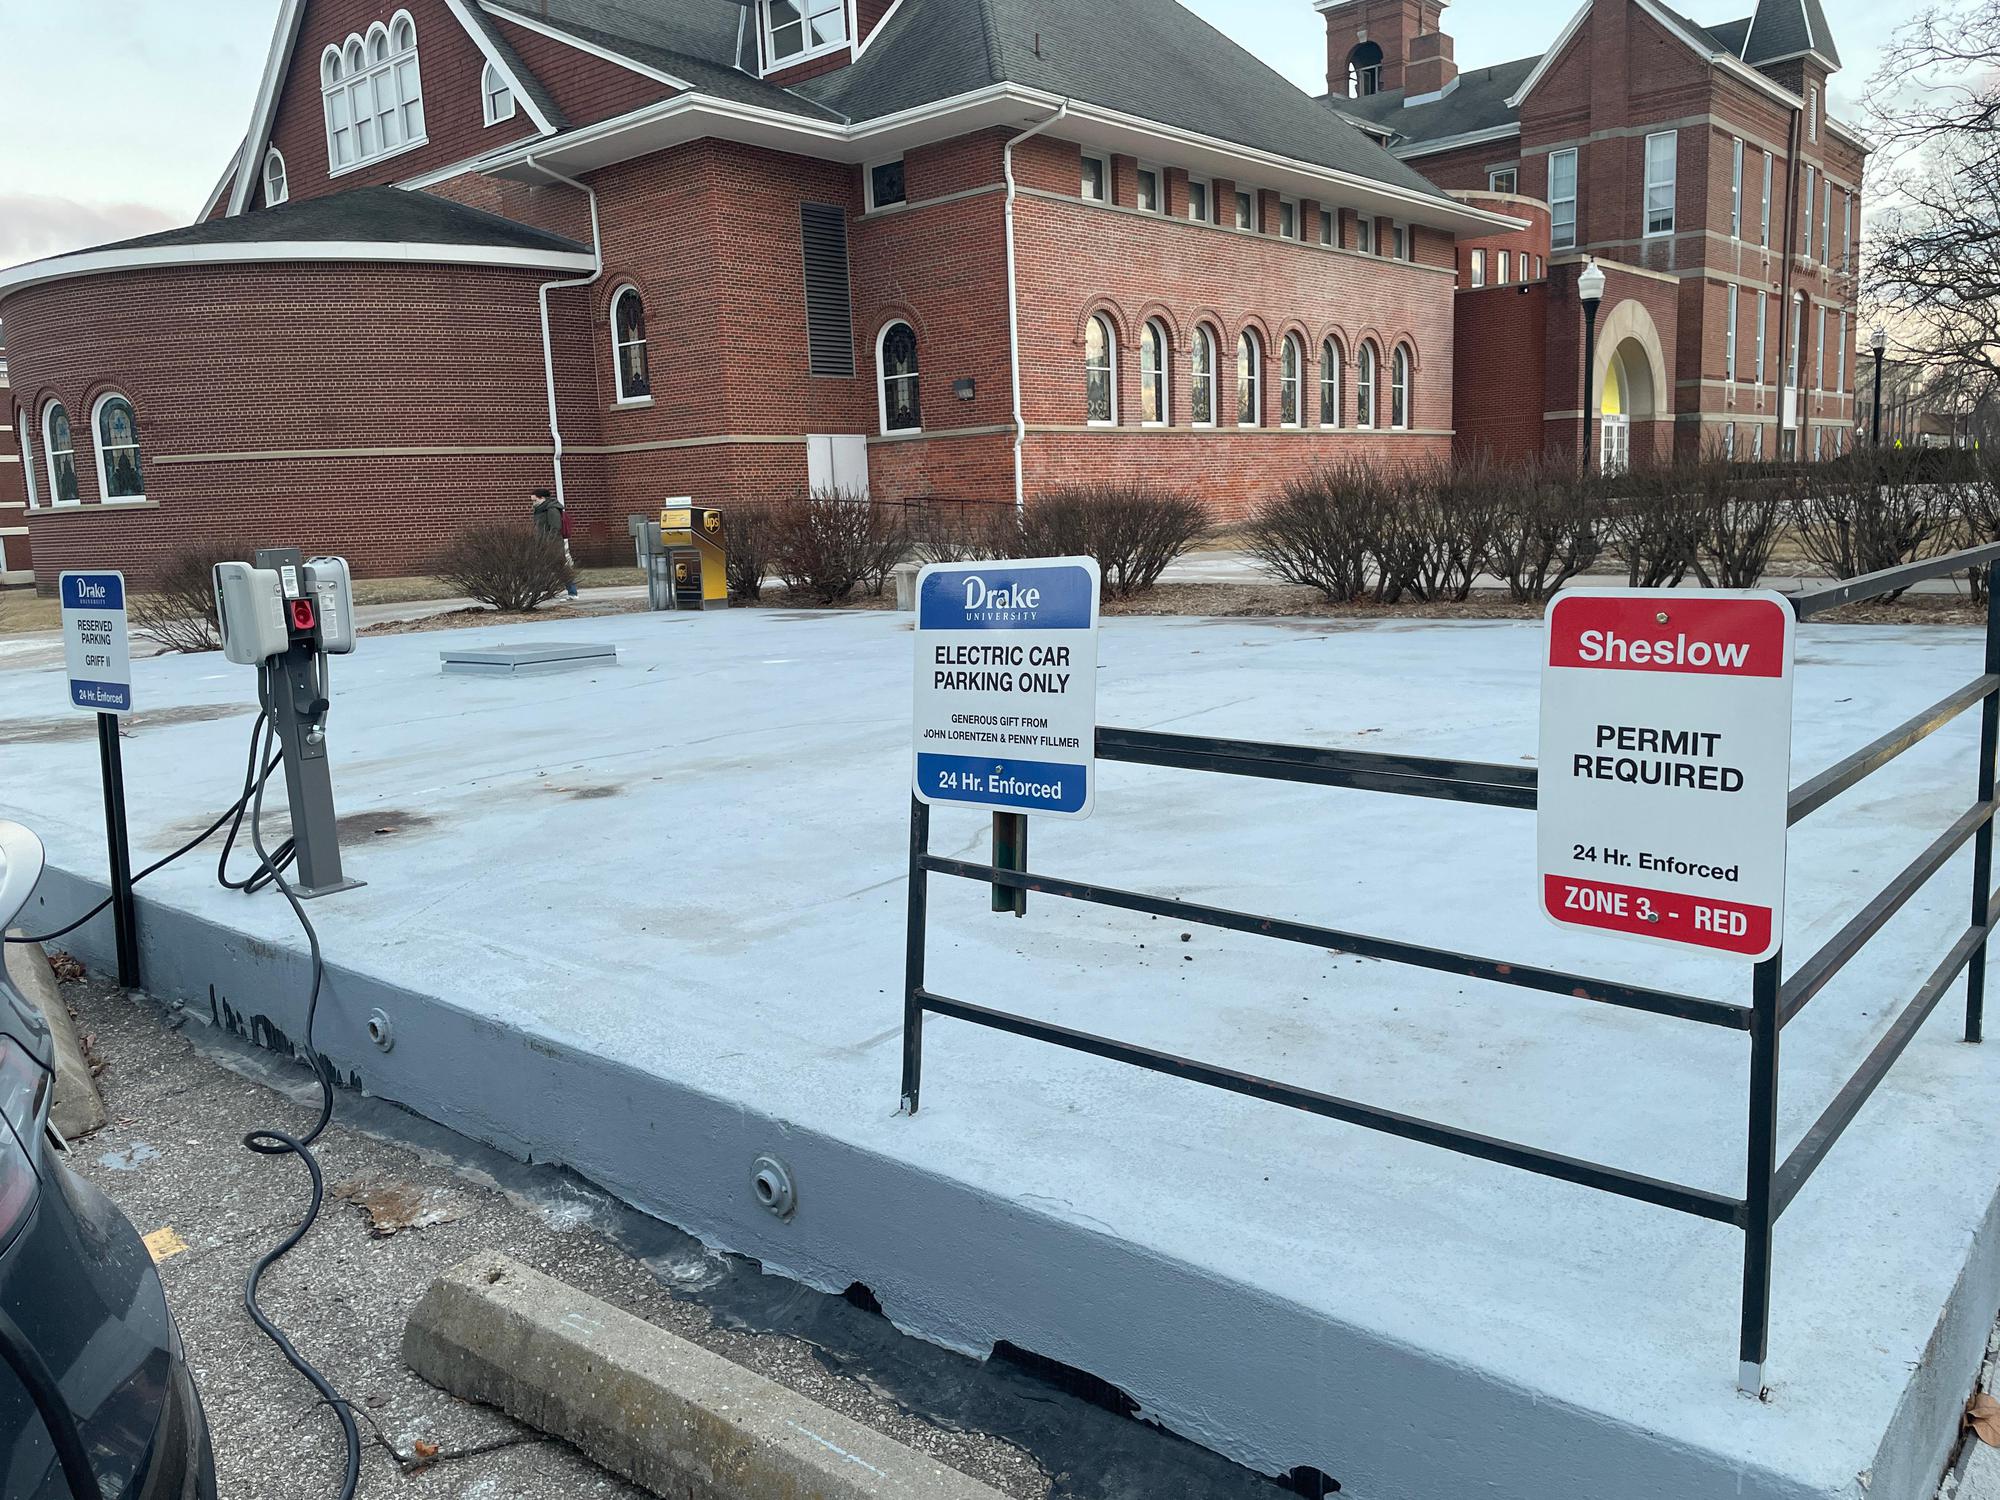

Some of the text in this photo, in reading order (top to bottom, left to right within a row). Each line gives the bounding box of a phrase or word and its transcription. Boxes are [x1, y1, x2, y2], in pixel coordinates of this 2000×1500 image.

[705, 518, 720, 531] ups
[76, 578, 106, 598] Drake
[962, 575, 1040, 609] Drake
[77, 620, 113, 632] RESERVED
[966, 612, 1037, 621] UNIVERSITY
[81, 633, 111, 645] PARKING
[1578, 629, 1750, 668] Sheslow
[85, 654, 105, 667] GRIFF
[935, 646, 1070, 667] ELECTRIC CAR
[934, 671, 1070, 693] PARKING ONLY
[78, 689, 123, 704] 24 Hr. Enforced
[951, 714, 1048, 729] GENEROUS GIFT FROM
[923, 729, 1080, 748] JOHN LORENTZEN & PENNY FILLMER
[1596, 724, 1722, 758] PERMIT
[1573, 754, 1744, 793] REQUIRED
[939, 771, 1063, 800] 24 Hr. Enforced
[1573, 844, 1739, 883] 24 Hr. Enforced
[1564, 885, 1628, 917] ZONE
[1636, 897, 1652, 921] 3
[1694, 905, 1748, 937] RED
